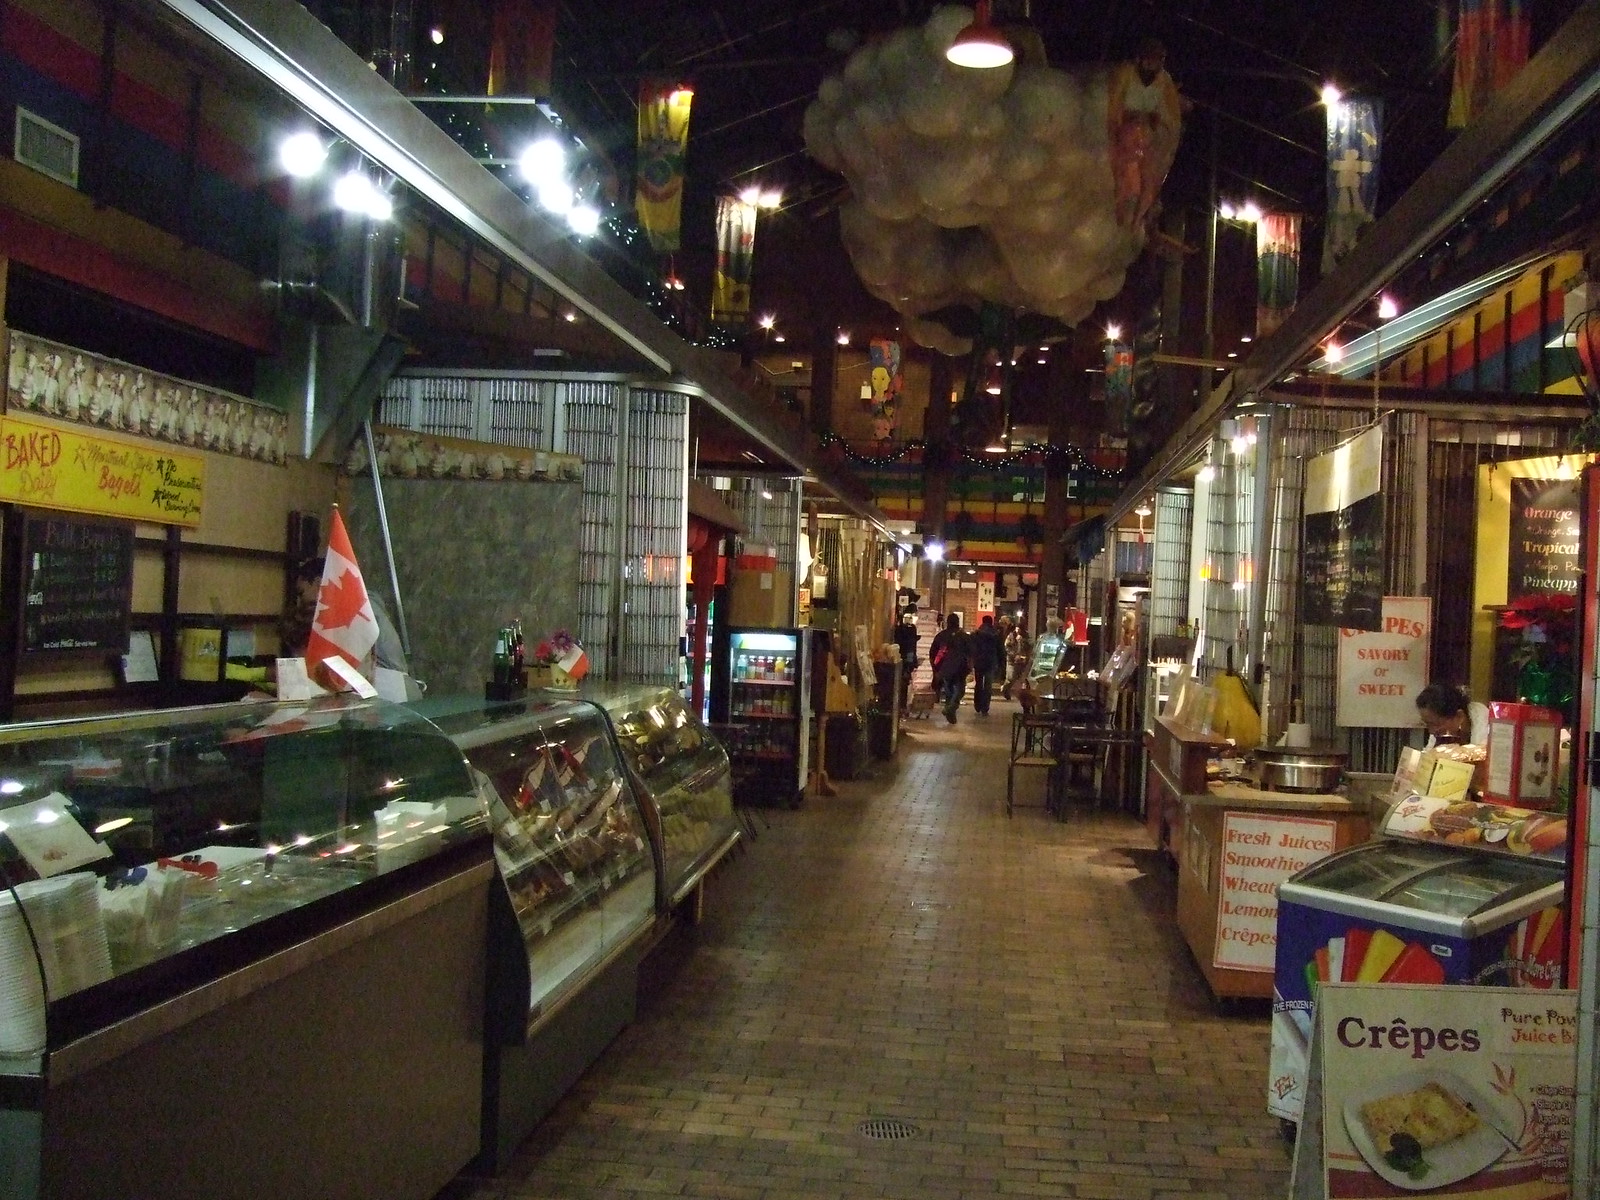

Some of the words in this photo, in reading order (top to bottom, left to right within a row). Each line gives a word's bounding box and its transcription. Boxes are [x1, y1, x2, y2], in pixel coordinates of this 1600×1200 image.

[6, 431, 61, 470] BAKED
[98, 465, 141, 499] Bagels
[1524, 507, 1573, 522] Orange
[1523, 541, 1580, 556] Tropical
[1358, 649, 1409, 661] SAVORY
[1374, 667, 1389, 677] or
[1358, 684, 1406, 695] SWEET
[1228, 829, 1271, 846] Fresh
[1280, 834, 1332, 851] Juices
[1226, 852, 1308, 872] Smoothie
[1225, 876, 1277, 894] Wheat
[1221, 927, 1277, 946] Crêpes
[1285, 1000, 1309, 1010] FROZEN
[1501, 1008, 1541, 1025] Pure
[1337, 1017, 1480, 1059] Crêpes
[1512, 1028, 1557, 1043] Juice
